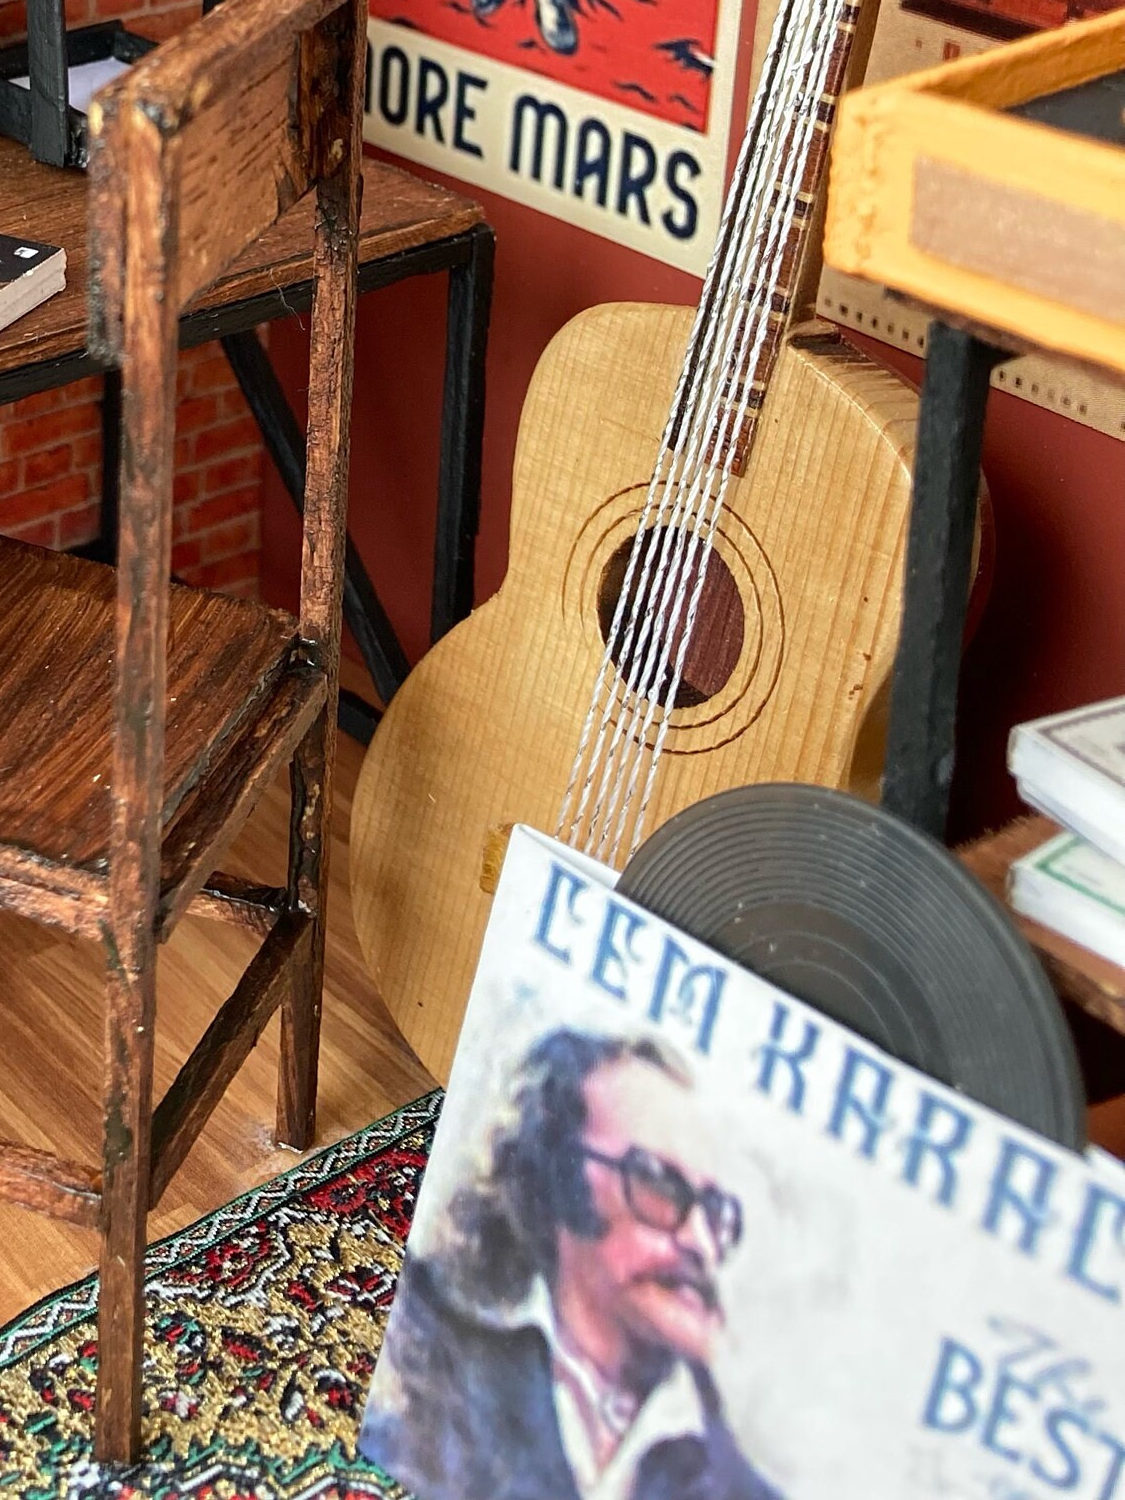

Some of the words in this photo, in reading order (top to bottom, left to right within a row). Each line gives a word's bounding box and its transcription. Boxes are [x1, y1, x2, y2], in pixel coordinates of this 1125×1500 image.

[364, 38, 490, 160] ORE
[509, 94, 703, 241] MARS
[532, 859, 728, 1056] CEM
